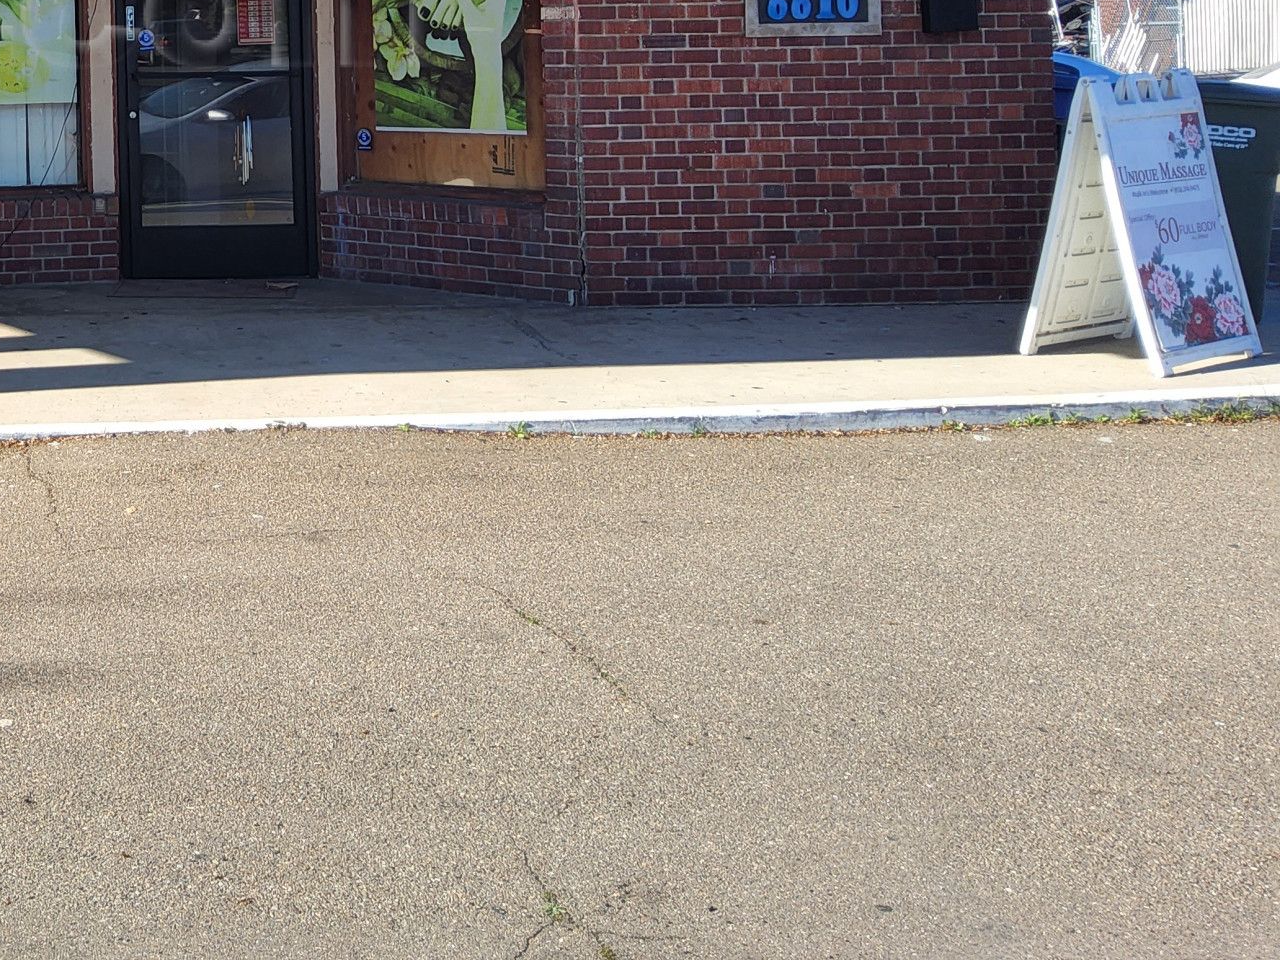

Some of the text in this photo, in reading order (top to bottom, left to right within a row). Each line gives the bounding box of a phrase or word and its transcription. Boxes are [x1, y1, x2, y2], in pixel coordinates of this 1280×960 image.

[1207, 125, 1256, 138] DCO
[1117, 162, 1207, 185] UNIQUE MASSAGE
[1180, 223, 1196, 235] FULL
[1197, 221, 1216, 233] BODY
